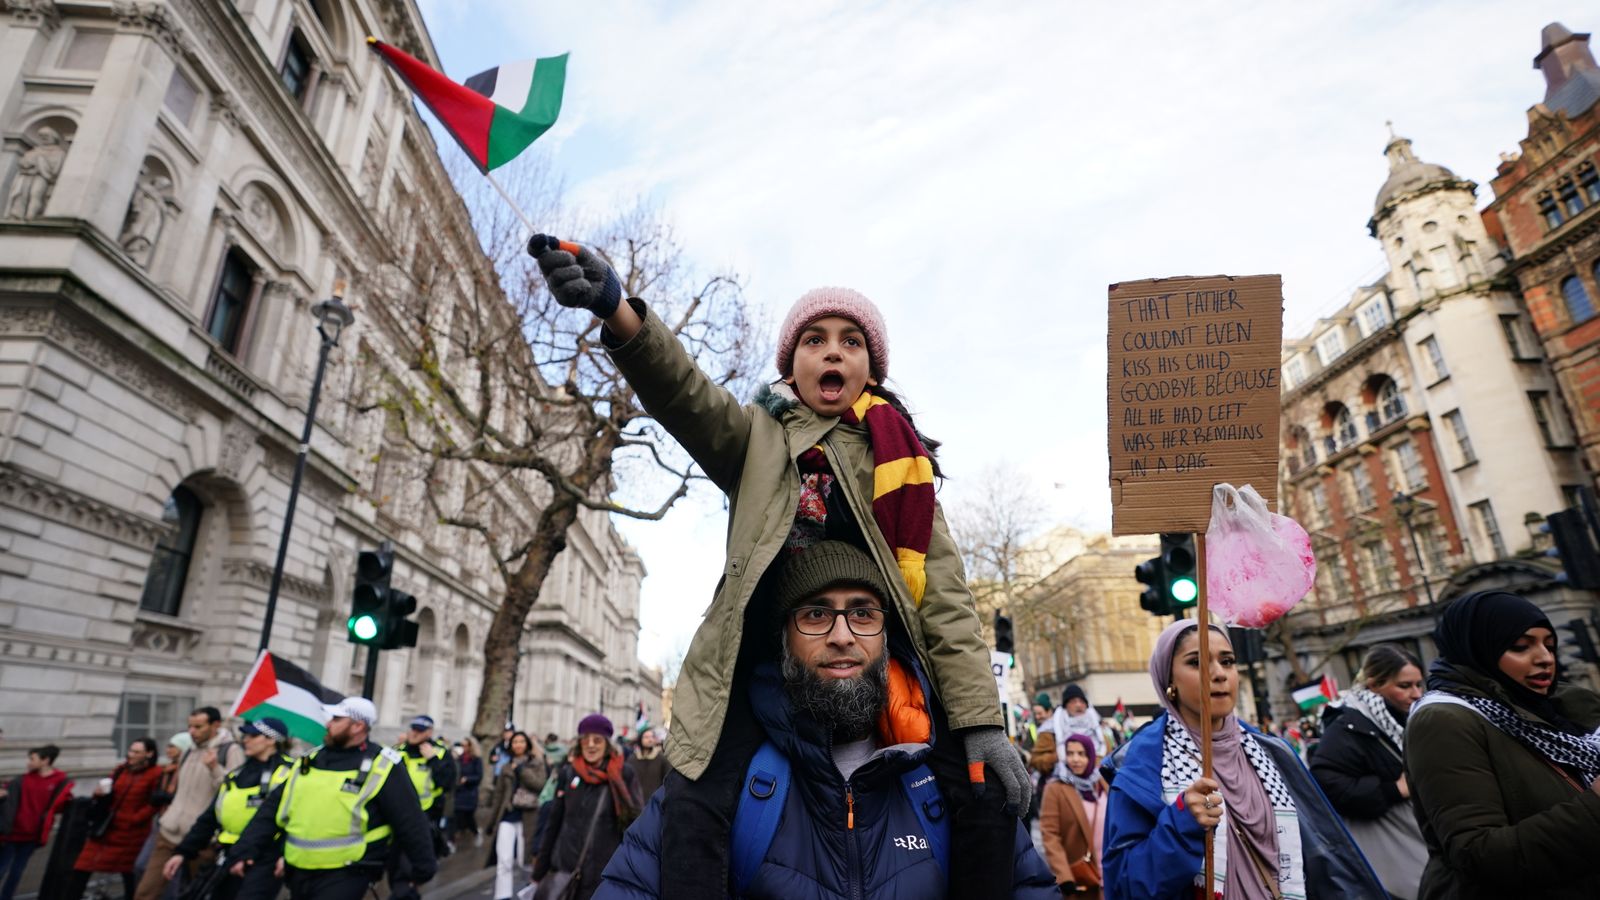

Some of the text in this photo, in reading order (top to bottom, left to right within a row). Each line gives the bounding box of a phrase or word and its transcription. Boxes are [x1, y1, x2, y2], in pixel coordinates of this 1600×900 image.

[1120, 289, 1244, 322] THAT FATHER
[1205, 319, 1252, 345] EVEN
[1122, 350, 1231, 378] KISS HIS CHILD
[1205, 368, 1278, 396] BECAUSE
[1123, 403, 1247, 426] ALL HE HAD LEFT
[1121, 424, 1264, 452] WAS HER REMAINS
[1130, 452, 1213, 477] IN A BAG.
[905, 835, 930, 850] Ra
